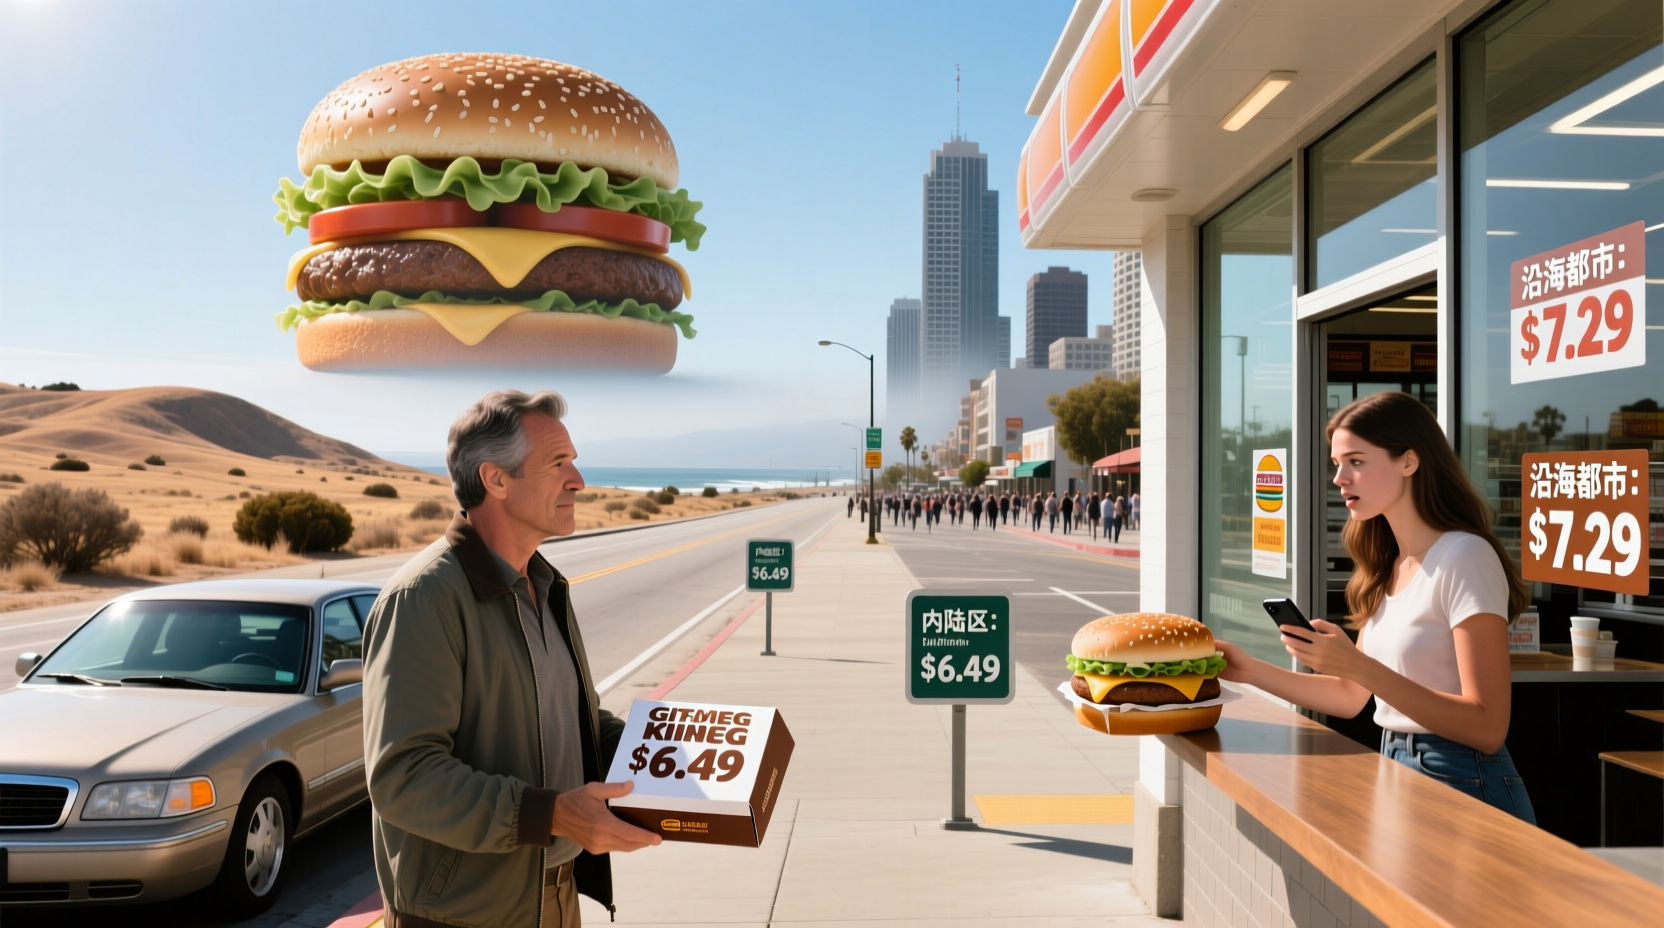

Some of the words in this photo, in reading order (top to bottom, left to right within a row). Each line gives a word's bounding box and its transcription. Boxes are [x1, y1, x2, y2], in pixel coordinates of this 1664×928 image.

[1521, 242, 1625, 300] 沿海都市：
[1521, 289, 1634, 366] $7.29
[1530, 461, 1639, 500] 沿海都市：
[1529, 506, 1642, 577] $7.29
[752, 566, 789, 580] $6.49
[922, 608, 997, 634] 内陆区：
[921, 652, 1000, 683] $6.49
[628, 743, 745, 782] $6.49
